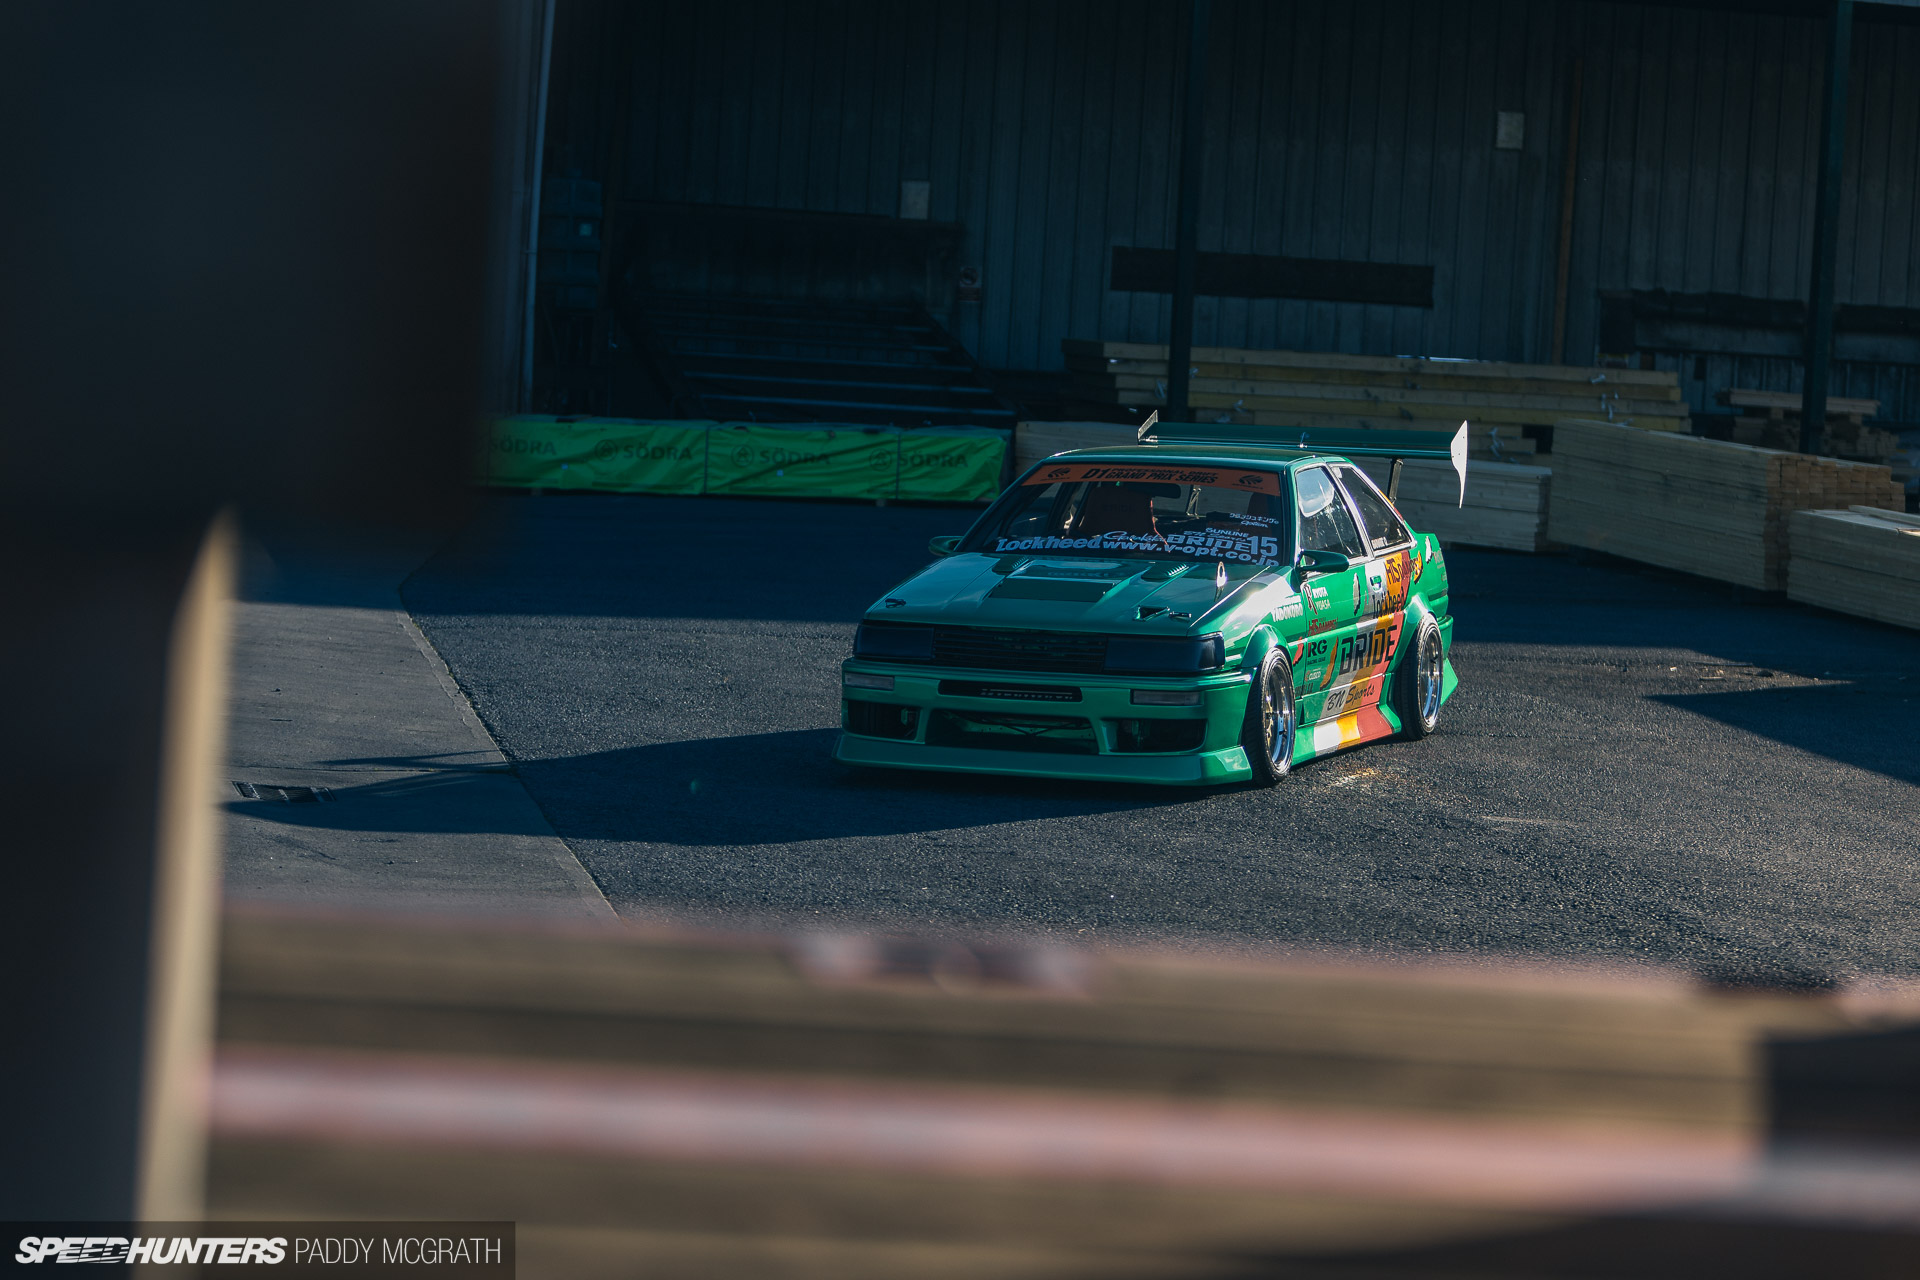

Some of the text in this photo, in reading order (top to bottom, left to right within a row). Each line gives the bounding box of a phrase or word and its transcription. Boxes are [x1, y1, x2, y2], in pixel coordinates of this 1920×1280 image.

[624, 441, 692, 461] SÖDRA
[760, 447, 831, 465] SÖDRA
[899, 451, 968, 469] SÖDRA
[1081, 468, 1111, 479] D1
[1105, 471, 1218, 483] GRAND PRIX SERIES
[1205, 527, 1249, 541] SUNLINE
[996, 535, 1102, 552] Lockheed
[1167, 534, 1252, 553] BRIDE
[1247, 535, 1278, 557] 15
[1103, 541, 1280, 567] www.v-opt.co.jp
[1307, 639, 1328, 658] RG
[1340, 625, 1398, 675] BRIDE
[1327, 689, 1346, 711] BN
[1345, 683, 1375, 706] Sports
